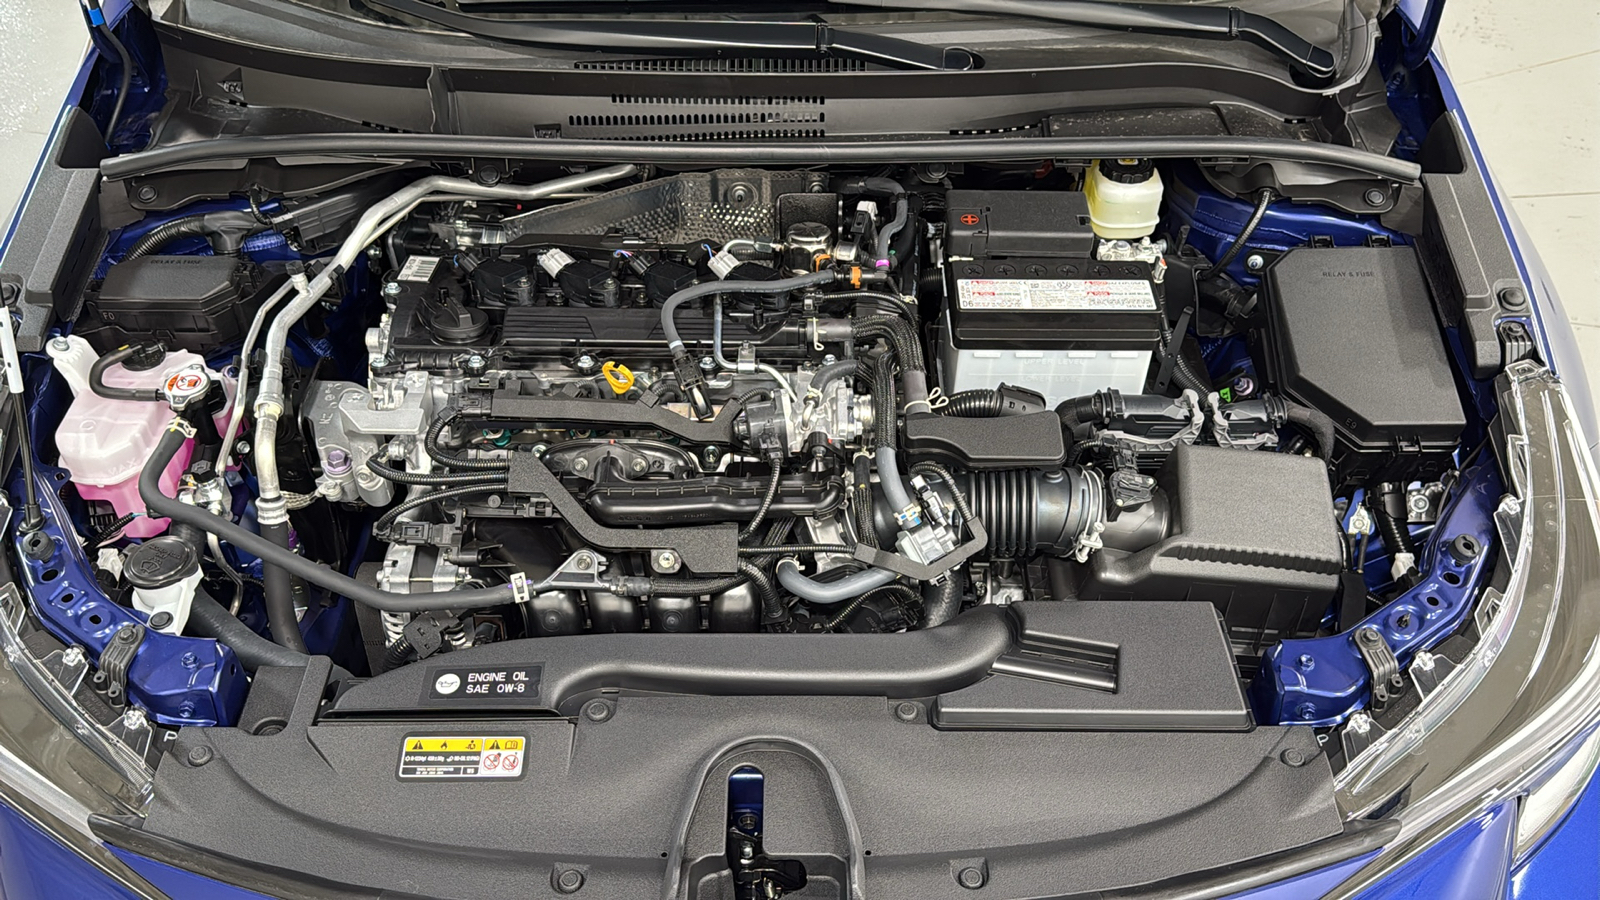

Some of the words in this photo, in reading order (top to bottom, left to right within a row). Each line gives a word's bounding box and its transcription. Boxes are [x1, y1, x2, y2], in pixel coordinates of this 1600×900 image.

[467, 672, 507, 682] ENGINE
[512, 671, 529, 681] OIL
[465, 683, 490, 694] SAE
[496, 683, 525, 693] 0W-8
